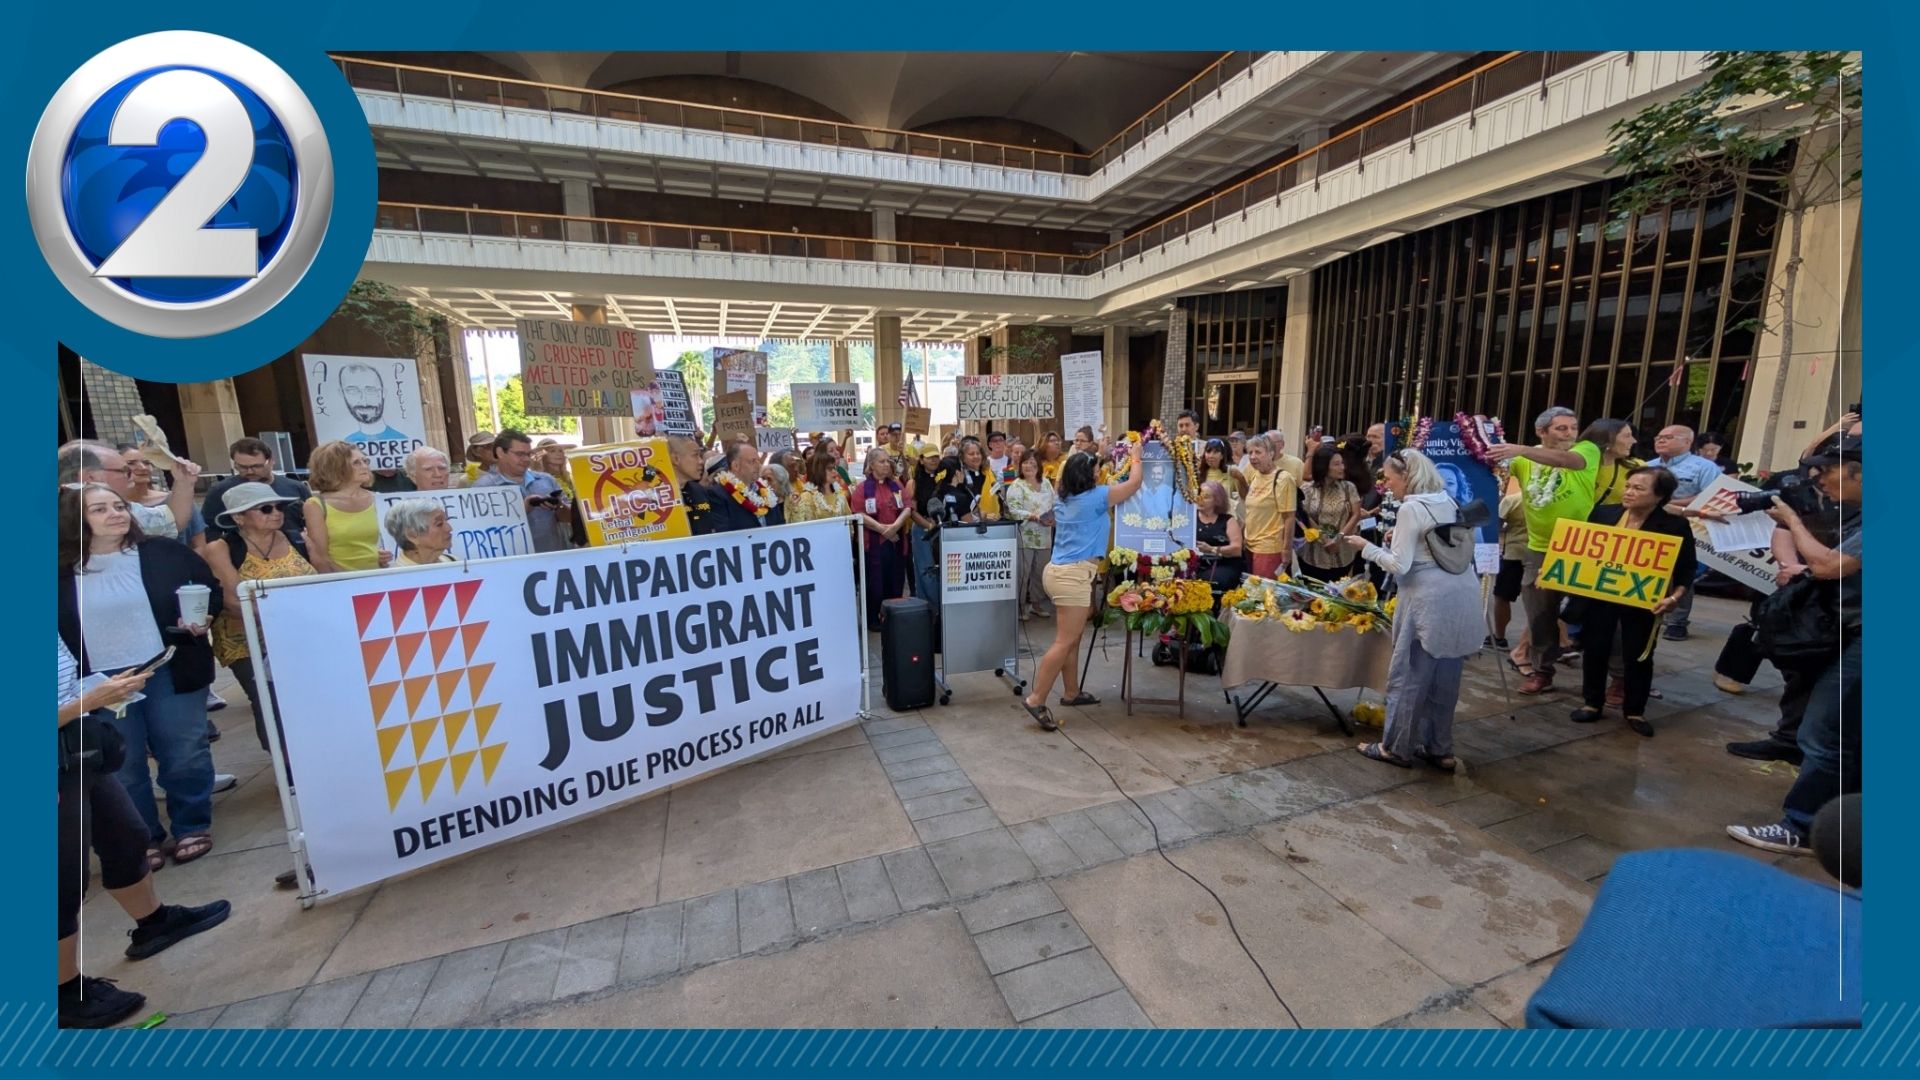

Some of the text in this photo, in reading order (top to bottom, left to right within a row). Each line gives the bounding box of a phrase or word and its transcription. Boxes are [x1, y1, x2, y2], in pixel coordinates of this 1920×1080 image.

[524, 320, 639, 350] THE ONLY GOOD ICE
[523, 343, 635, 369] IS CRUSHED ICE
[526, 366, 589, 386] MELTED
[612, 370, 646, 389] GLASS
[664, 372, 678, 380] DAY
[989, 376, 1002, 385] ICE
[1007, 376, 1035, 385] MUST
[1036, 375, 1054, 385] NOT
[312, 360, 330, 416] Alex
[528, 386, 544, 405] of
[813, 389, 856, 397] CAMPAIGN FOR
[665, 400, 688, 408] LWAYS
[814, 397, 857, 407] IMMIGRANT
[959, 402, 1053, 418] EXECUTIONER
[527, 406, 574, 415] RESPECT
[667, 410, 685, 418] BEEN
[720, 405, 744, 417] KEITH
[815, 408, 858, 419] JUSTICE
[356, 439, 424, 456] RDERED
[758, 432, 789, 448] MORE
[1426, 438, 1466, 448] unity Vig
[588, 446, 654, 473] STOP
[1426, 448, 1455, 456] Nicole
[1457, 448, 1471, 456] Go
[377, 456, 403, 468] ICE
[384, 489, 522, 520] EMBER
[582, 484, 683, 520] L.I.C.E.
[600, 516, 634, 530] Lethal
[604, 523, 666, 542] Immigration
[457, 523, 529, 560] PRETTI
[1551, 526, 1676, 571] JUSTICE
[965, 550, 1012, 560] CAMPAIGN FOR
[965, 560, 1011, 571] IMMIGRANT
[1595, 560, 1624, 571] FOR
[1735, 557, 1774, 581] PROCESS
[523, 538, 815, 617] CAMPAIGN FOR
[964, 570, 1012, 584] JUSTICE
[1542, 558, 1666, 603] ALEX!
[531, 583, 816, 688] IMMIGRANT
[538, 638, 825, 772] JUSTICE
[393, 701, 825, 860] DEFENDING DUE PROCESS FOR ALL
